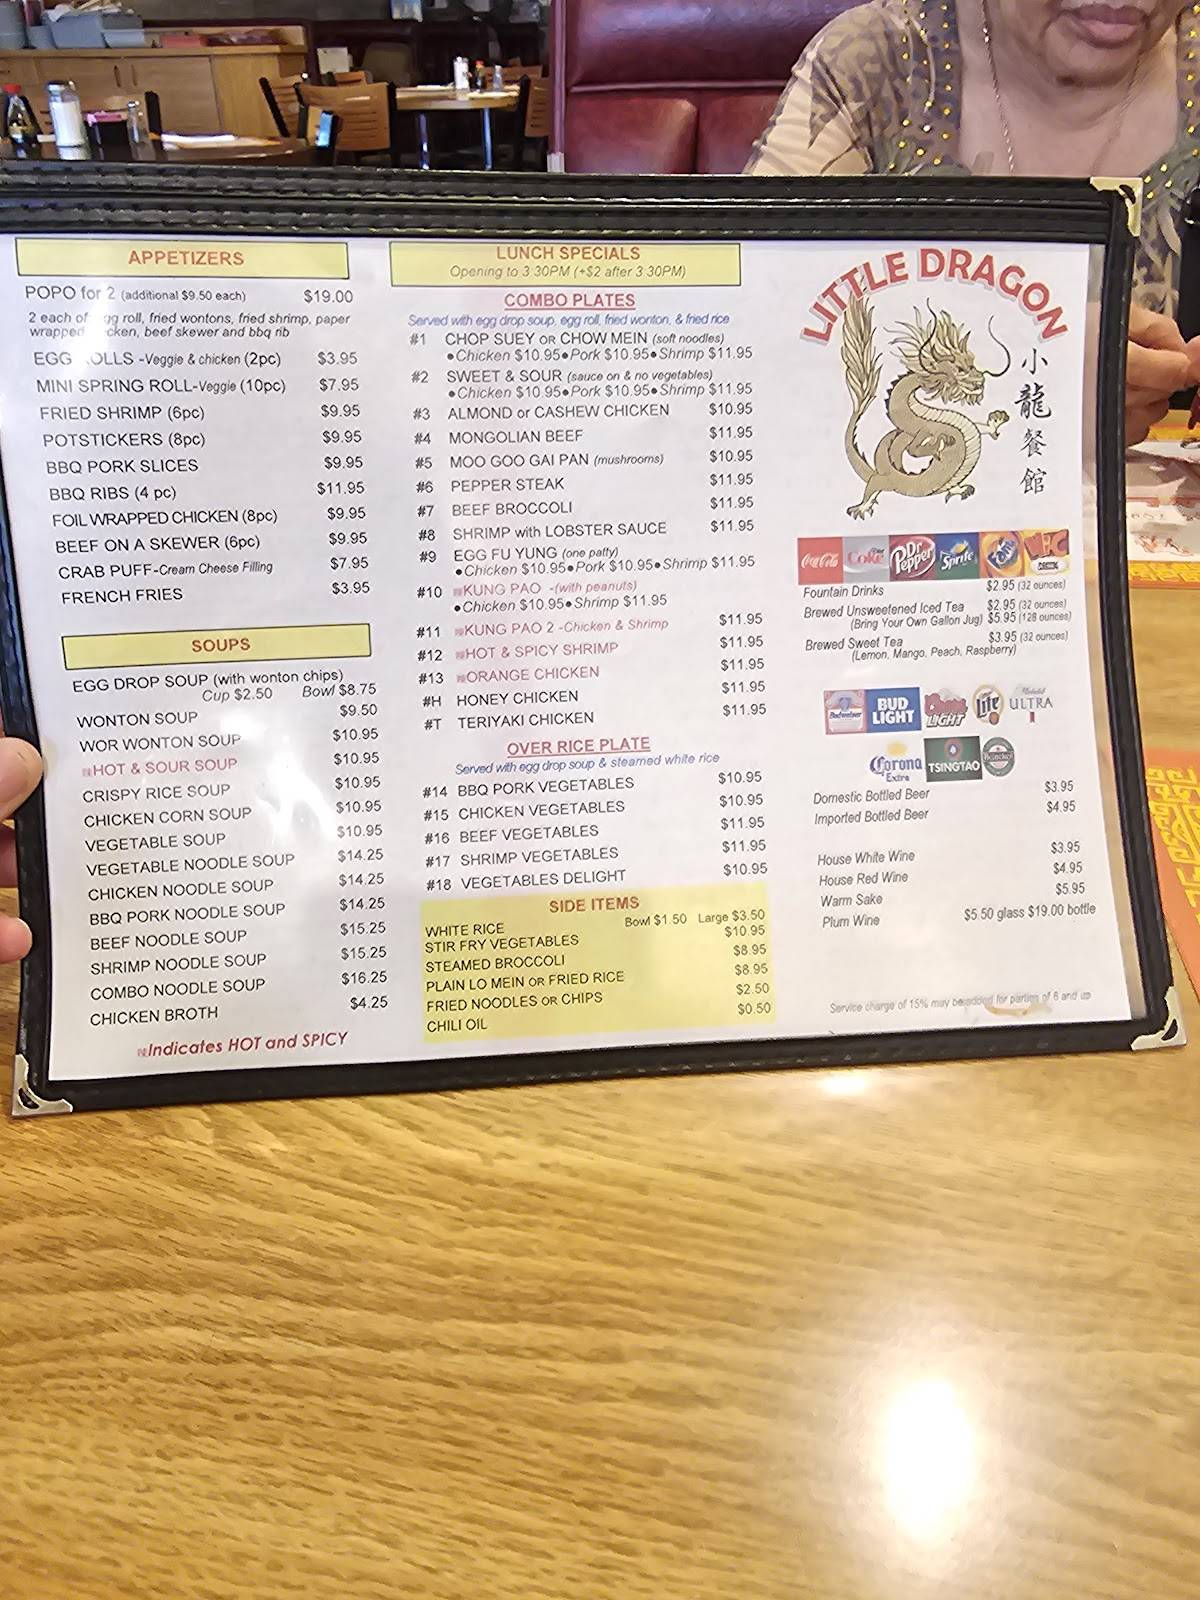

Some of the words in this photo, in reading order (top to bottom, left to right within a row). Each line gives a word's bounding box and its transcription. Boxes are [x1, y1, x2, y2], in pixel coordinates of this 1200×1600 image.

[129, 251, 244, 265] APPETIZERS
[497, 246, 553, 259] LUNCH
[560, 244, 640, 260] SPECIALS
[504, 293, 566, 308] COMBO
[572, 292, 636, 308] PLATES
[802, 251, 909, 343] LITTLE
[919, 248, 1068, 341] DRAGON
[410, 333, 425, 345] #1
[445, 332, 489, 345] CHOP
[494, 332, 535, 345] SUEY
[561, 332, 608, 345] CHOW
[611, 331, 648, 345] MEIN
[652, 332, 677, 346] (soft
[679, 332, 725, 346] noodles)
[40, 407, 91, 420] FRIED
[97, 406, 162, 420] SHRIMP
[168, 406, 204, 423] (6pc)
[321, 404, 360, 418] $9.95
[413, 408, 430, 420] #3
[448, 406, 512, 420] ALMOND
[517, 409, 530, 419] or
[535, 405, 600, 418] CASHEW
[604, 404, 669, 417] CHICKEN
[709, 402, 752, 416] $10.95
[1014, 348, 1052, 495] 小龍餐館
[43, 433, 163, 447] POTSTICKERS
[168, 432, 205, 448] (8pc)
[323, 430, 362, 444] $9.95
[50, 488, 86, 502] BBQ
[91, 486, 129, 502] RIBS
[135, 486, 148, 503] (4
[154, 486, 176, 501] pc)
[317, 481, 365, 495] $11.95
[416, 480, 433, 493] #6
[451, 479, 511, 492] PEPPER
[516, 477, 564, 491] STEAK
[710, 473, 753, 487] $11.95
[418, 529, 435, 541] #8
[453, 527, 510, 540] SHRIMP
[515, 526, 541, 538] with
[546, 524, 613, 537] LOBSTER
[618, 522, 666, 535] SAUCE
[711, 519, 754, 533] $11.95
[56, 539, 98, 554] BEEF
[104, 537, 129, 552] ON
[134, 537, 146, 551] A
[150, 536, 223, 552] SKEWER
[225, 535, 260, 551] (6pc)
[329, 531, 367, 546] $9.95
[906, 541, 923, 558] Dr
[59, 566, 105, 579] CRAB
[199, 562, 239, 574] Cheese
[242, 561, 273, 574] Filling
[331, 556, 368, 570] $7.95
[890, 546, 934, 575] Pepper
[941, 550, 975, 570] Sprite
[62, 590, 130, 604] FRENCH
[136, 588, 183, 601] FRIES
[332, 581, 370, 595] $3.95
[803, 585, 849, 599] Fountain
[851, 585, 884, 597] Drinks
[986, 579, 1015, 592] $2.95
[1017, 580, 1032, 592] (32
[1033, 579, 1066, 591] ounces)
[804, 605, 844, 618] Brewed
[847, 603, 917, 617] Unsweetened
[919, 602, 943, 614] Iced
[945, 601, 965, 613] Tea
[192, 638, 250, 652] SOUPS
[852, 650, 889, 663] (Lemon,
[931, 646, 962, 657] Peach,
[966, 644, 1016, 657] Raspberry)
[73, 679, 109, 692] EGG
[114, 675, 159, 690] DROP
[164, 673, 208, 689] SOUP
[213, 671, 246, 687] (with
[249, 671, 299, 685] wonton
[303, 669, 344, 684] chips)
[202, 686, 230, 703] Cup
[234, 687, 272, 701] $2.50
[302, 682, 335, 697] Bowl
[339, 681, 376, 697] $8.75
[423, 696, 441, 707] #H
[457, 692, 509, 706] HONEY
[513, 690, 578, 704] CHICKEN
[722, 681, 765, 694] $11.95
[877, 697, 909, 711] BUD
[976, 695, 1000, 719] Lite
[1009, 697, 1053, 710] ULTRA
[424, 718, 442, 730] #T
[457, 713, 524, 728] TERIYAKI
[529, 712, 594, 726] CHICKEN
[723, 703, 766, 717] $11.95
[872, 709, 915, 725] LIGHT
[926, 714, 966, 728] LIGHT
[507, 740, 554, 757] OVER
[558, 739, 595, 755] RICE
[600, 737, 651, 753] PLATE
[869, 755, 923, 776] Corona
[928, 759, 981, 773] TSINGTAO
[886, 772, 910, 783] Extra
[813, 791, 862, 804] Domestic
[866, 789, 902, 802] Bottled
[905, 788, 930, 800] Beer
[1045, 780, 1073, 793] $3.95
[815, 811, 861, 826] Imported
[865, 809, 901, 822] Bottled
[904, 808, 929, 820] Beer
[1047, 800, 1075, 814] $4.95
[818, 854, 852, 866] House
[855, 852, 885, 863] White
[888, 850, 915, 862] Wine
[1051, 841, 1080, 854] $3.95
[88, 885, 158, 902] CHICKEN
[163, 882, 226, 896] NOODLE
[232, 879, 273, 893] SOUP
[339, 873, 384, 887] $14.25
[821, 895, 852, 907] Warm
[856, 893, 883, 905] Sake
[1056, 882, 1085, 895] $5.95
[550, 899, 585, 913] SIDE
[592, 896, 639, 910] ITEMS
[425, 925, 468, 937] WHITE
[473, 923, 504, 938] RICE
[625, 916, 650, 928] Bowl
[653, 913, 687, 927] $1.50
[698, 912, 729, 926] Large
[732, 909, 765, 922] $3.50
[91, 960, 151, 976] SHRIMP
[156, 956, 219, 972] NOODLE
[224, 953, 266, 967] SOUP
[341, 946, 387, 960] $15.25
[426, 959, 491, 973] STEAMED
[495, 954, 564, 969] BROCCOLI
[734, 944, 766, 956] $8.95
[90, 1009, 159, 1026] CHICKEN
[165, 1006, 218, 1022] BROTH
[350, 995, 388, 1010] $4.25
[427, 1019, 461, 1032] CHILI
[466, 1018, 487, 1030] OIL
[738, 1002, 771, 1015] $0.50
[148, 1040, 222, 1056] Indicates
[228, 1036, 262, 1051] HOT
[265, 1034, 297, 1049] and
[302, 1032, 348, 1047] SPICY
